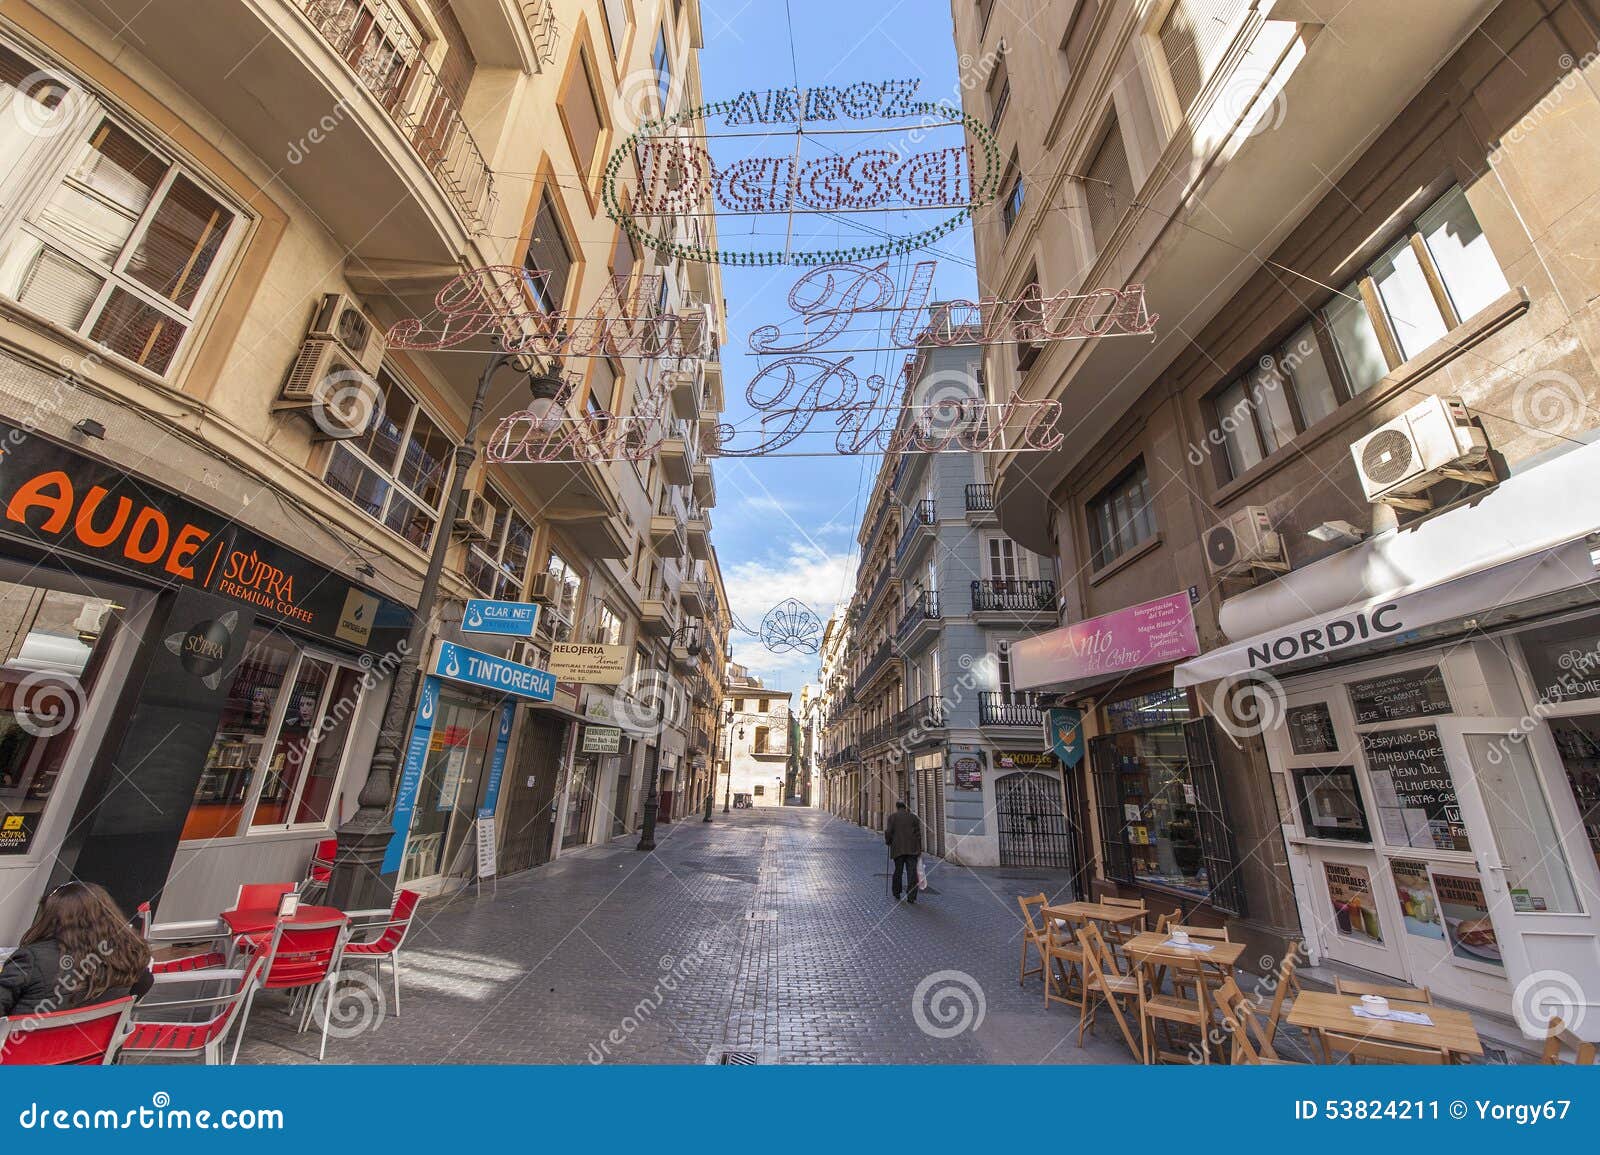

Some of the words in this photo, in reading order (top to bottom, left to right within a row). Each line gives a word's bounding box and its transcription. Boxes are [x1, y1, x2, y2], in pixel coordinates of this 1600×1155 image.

[724, 78, 921, 126] ARROZ
[219, 579, 275, 609] PREMIUM
[276, 600, 315, 624] COFFEE
[484, 606, 508, 617] CLAR
[512, 609, 532, 619] NET
[553, 644, 605, 656] RELOJERIA
[1247, 604, 1403, 668] NORDIC
[468, 656, 551, 696] TINTORERÍA
